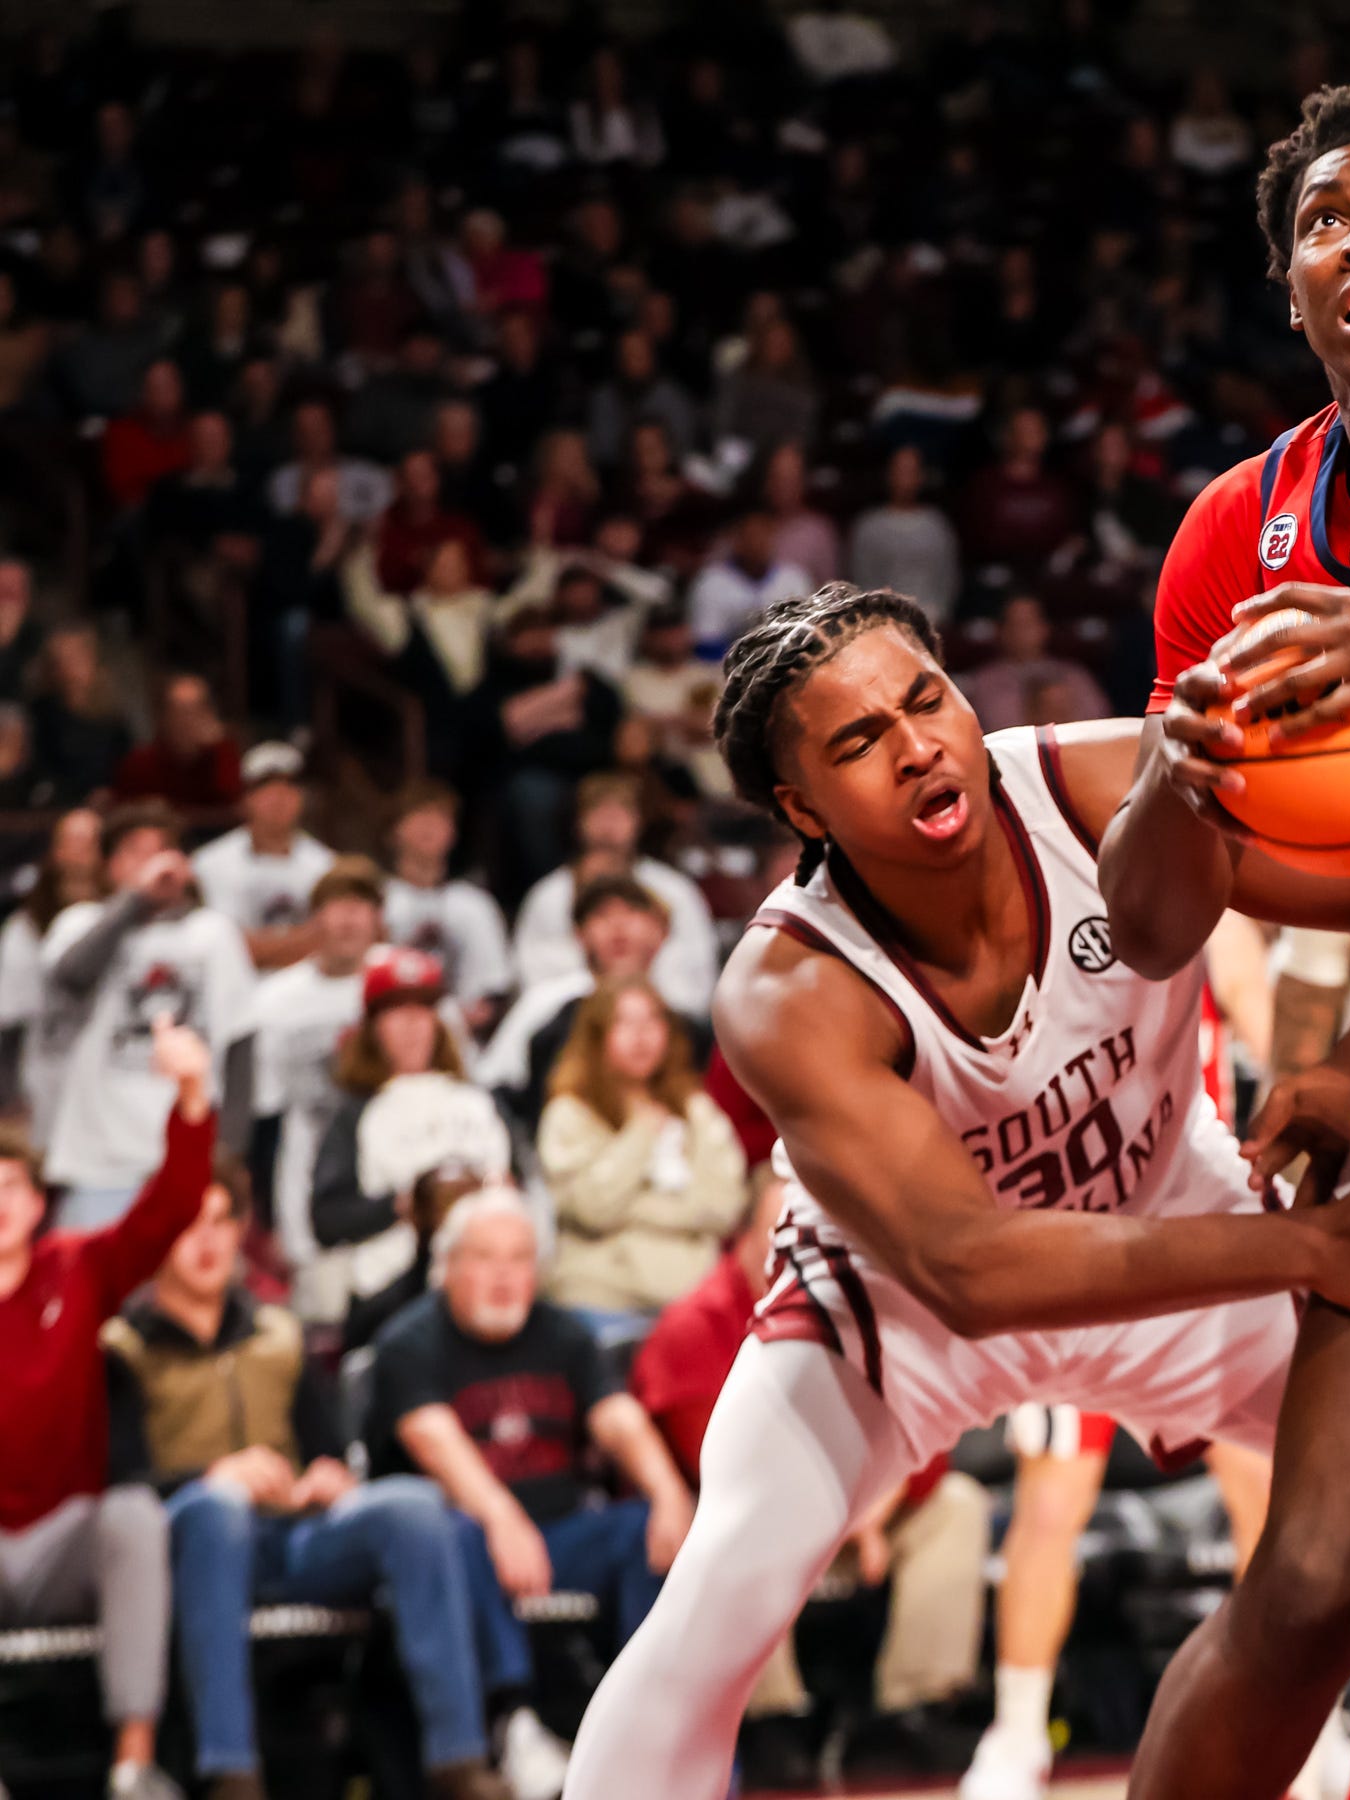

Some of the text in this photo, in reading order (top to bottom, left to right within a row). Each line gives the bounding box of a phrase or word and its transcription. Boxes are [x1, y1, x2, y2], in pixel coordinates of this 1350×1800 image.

[1266, 533, 1290, 560] 22
[961, 1026, 1136, 1174] SOUTH
[997, 1097, 1123, 1209] 30
